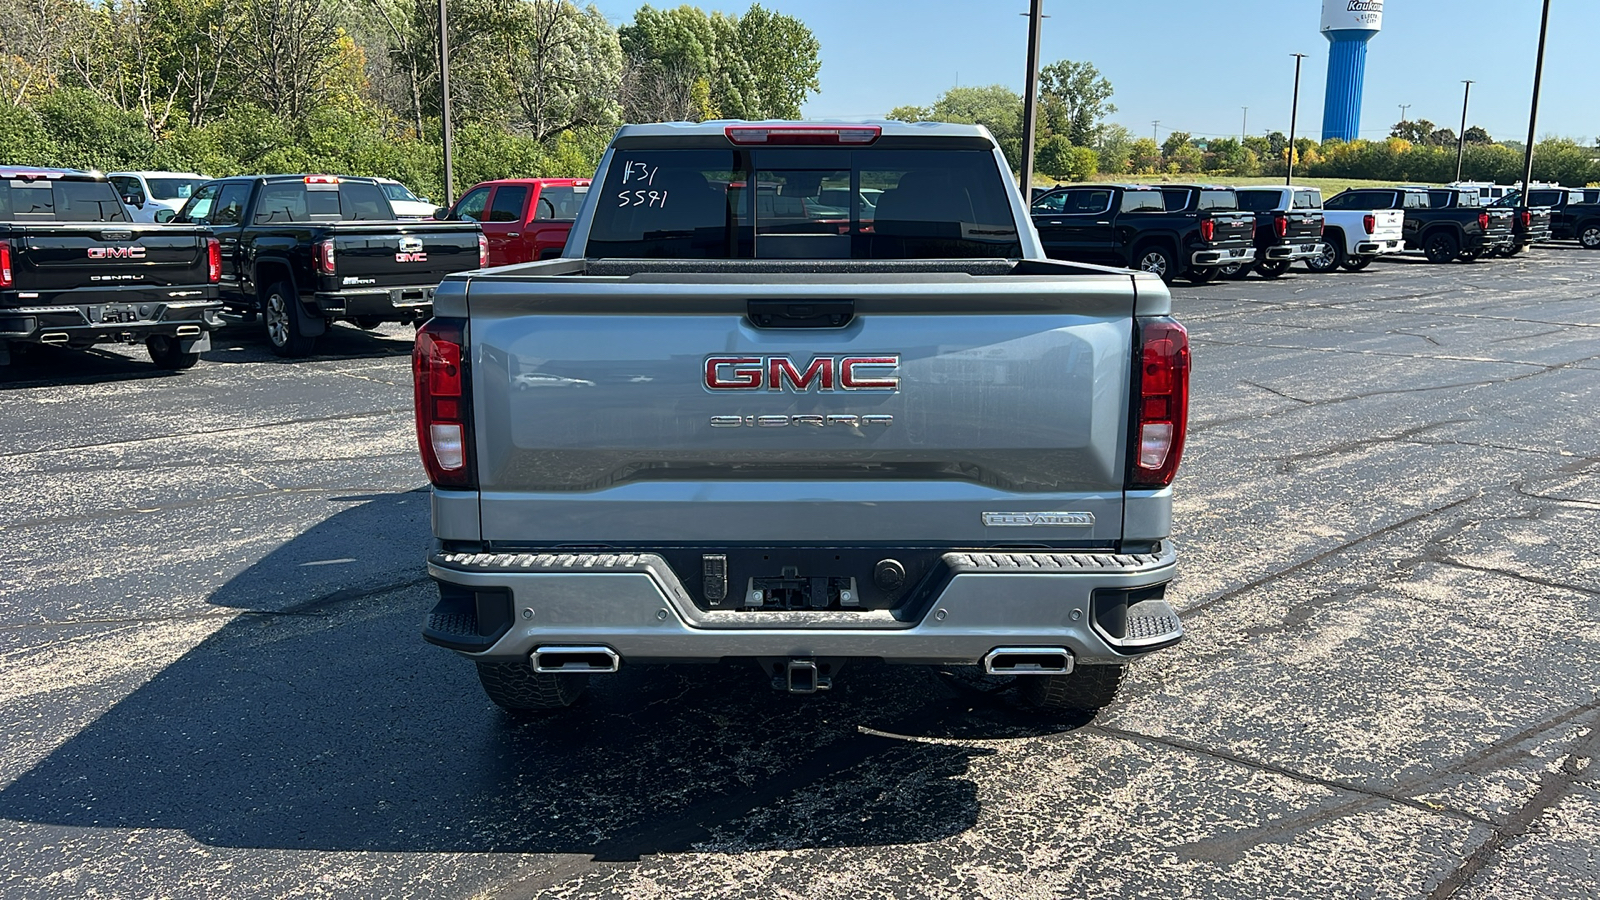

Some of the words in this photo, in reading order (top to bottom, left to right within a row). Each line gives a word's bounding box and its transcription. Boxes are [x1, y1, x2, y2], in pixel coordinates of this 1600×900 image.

[87, 246, 147, 259] GMC
[395, 252, 428, 262] GMC
[704, 355, 901, 392] GMC
[709, 414, 895, 428] SIERRA
[990, 514, 1087, 524] ELEVATION
